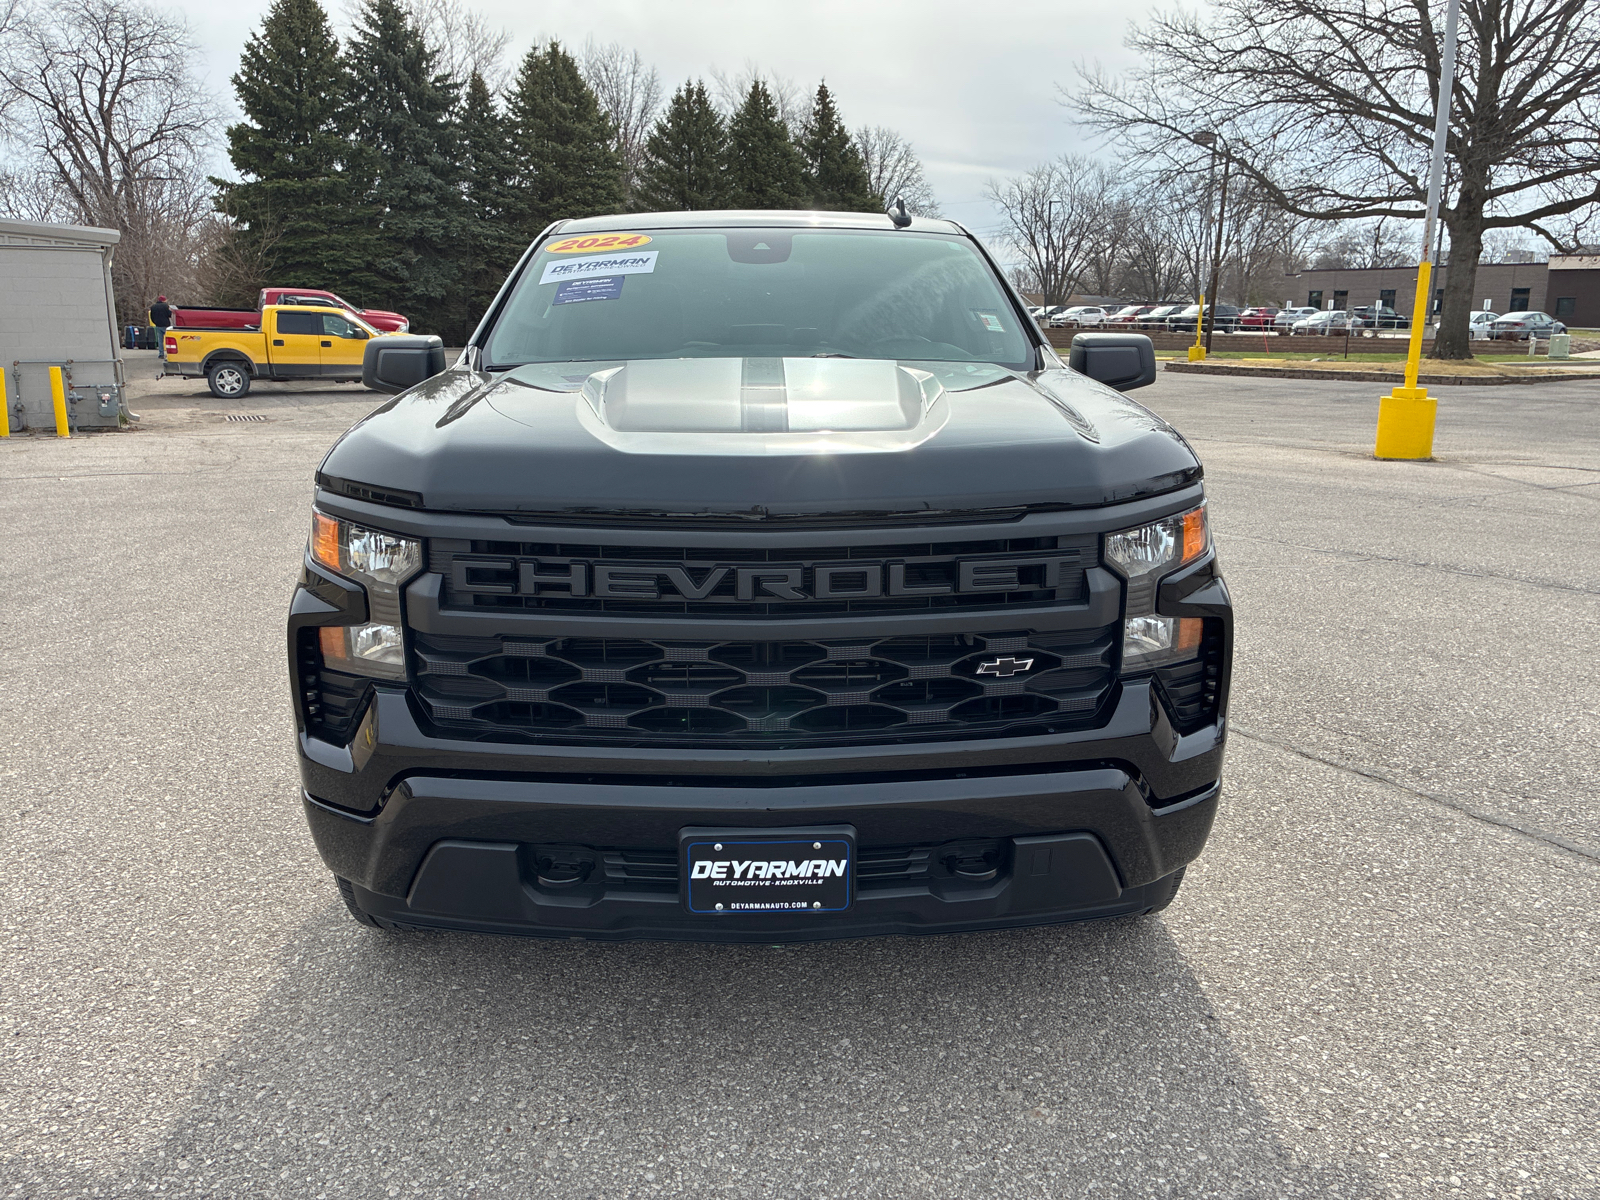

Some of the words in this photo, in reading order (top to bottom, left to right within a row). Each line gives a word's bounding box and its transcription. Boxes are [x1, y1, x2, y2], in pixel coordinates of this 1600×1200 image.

[553, 236, 642, 251] 2024
[550, 257, 650, 273] DEYARMAN
[556, 266, 598, 276] CERTIFIED
[599, 263, 646, 271] PRE-OWNED
[452, 551, 1081, 600] CHEVROLET
[690, 859, 847, 879] DEYARMAN
[731, 902, 807, 910] DEYARMANAUTO.COM
